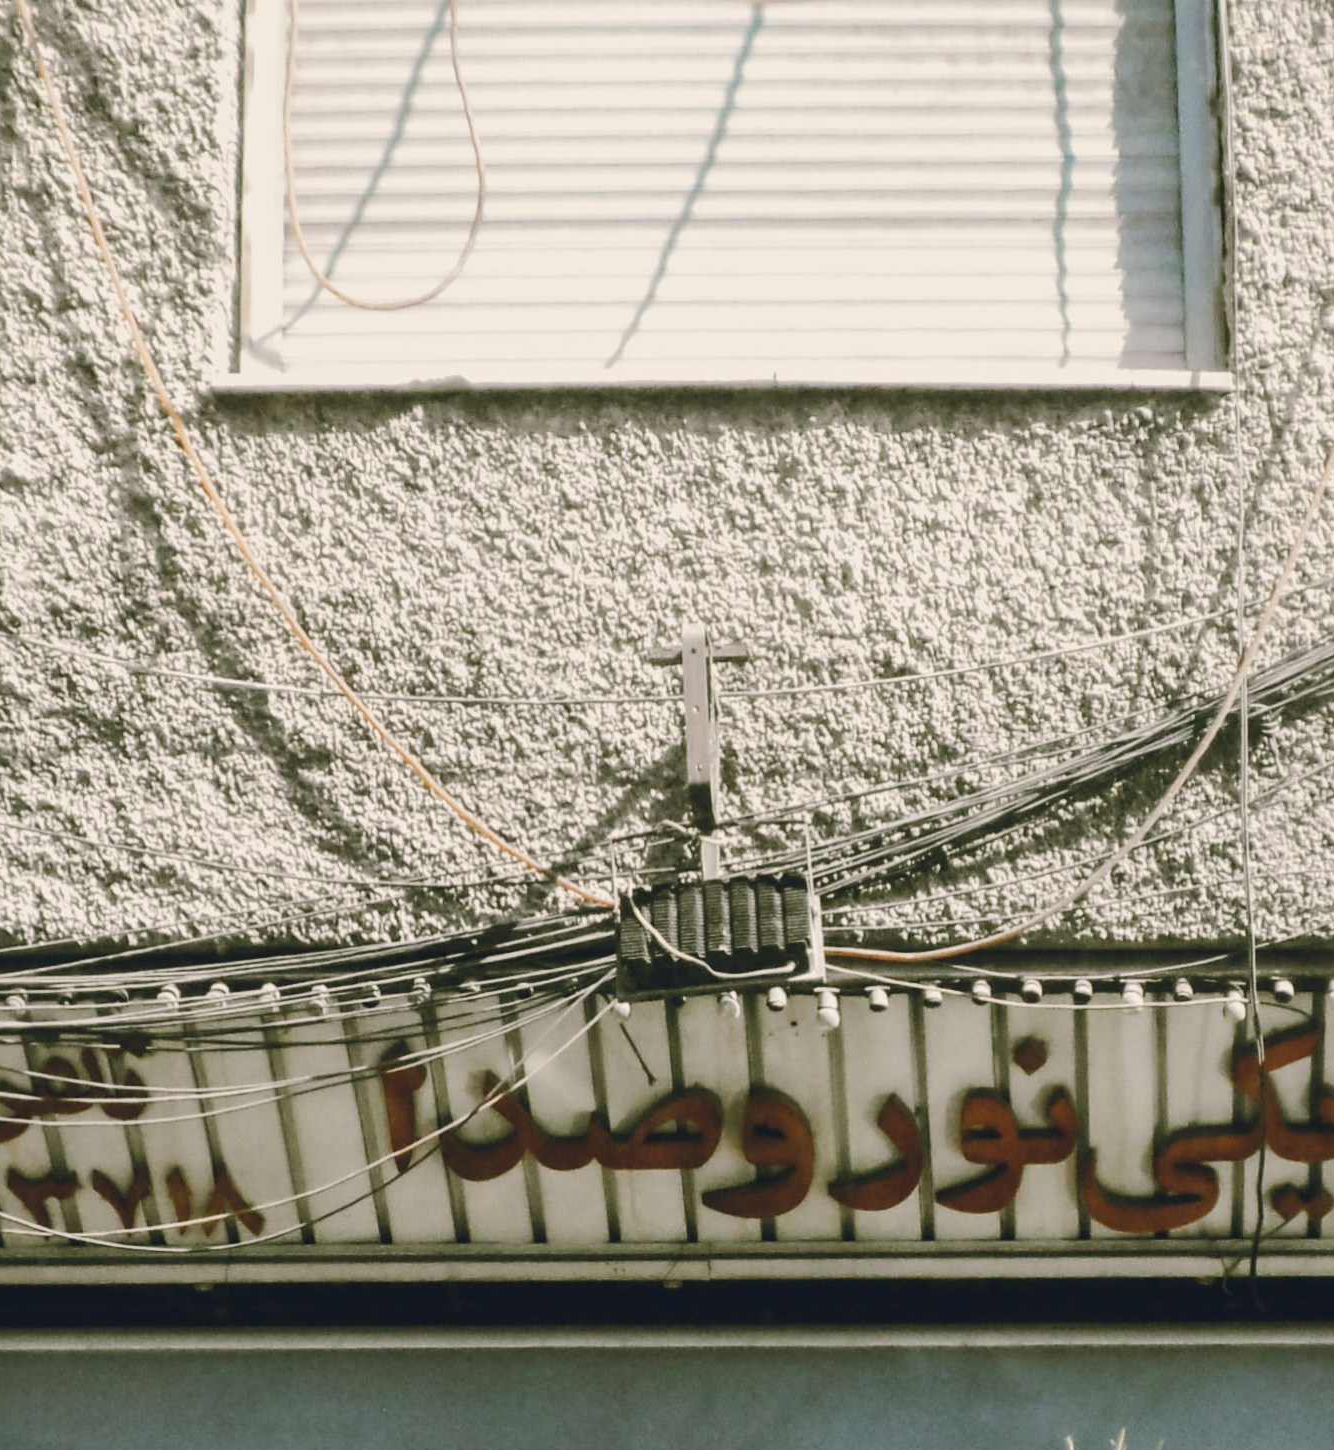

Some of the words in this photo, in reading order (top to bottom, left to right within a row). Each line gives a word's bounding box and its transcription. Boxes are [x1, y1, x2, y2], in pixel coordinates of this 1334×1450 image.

[380, 1039, 724, 1182] صدا
[702, 1085, 814, 1219] و
[828, 1036, 1078, 1214] نور
